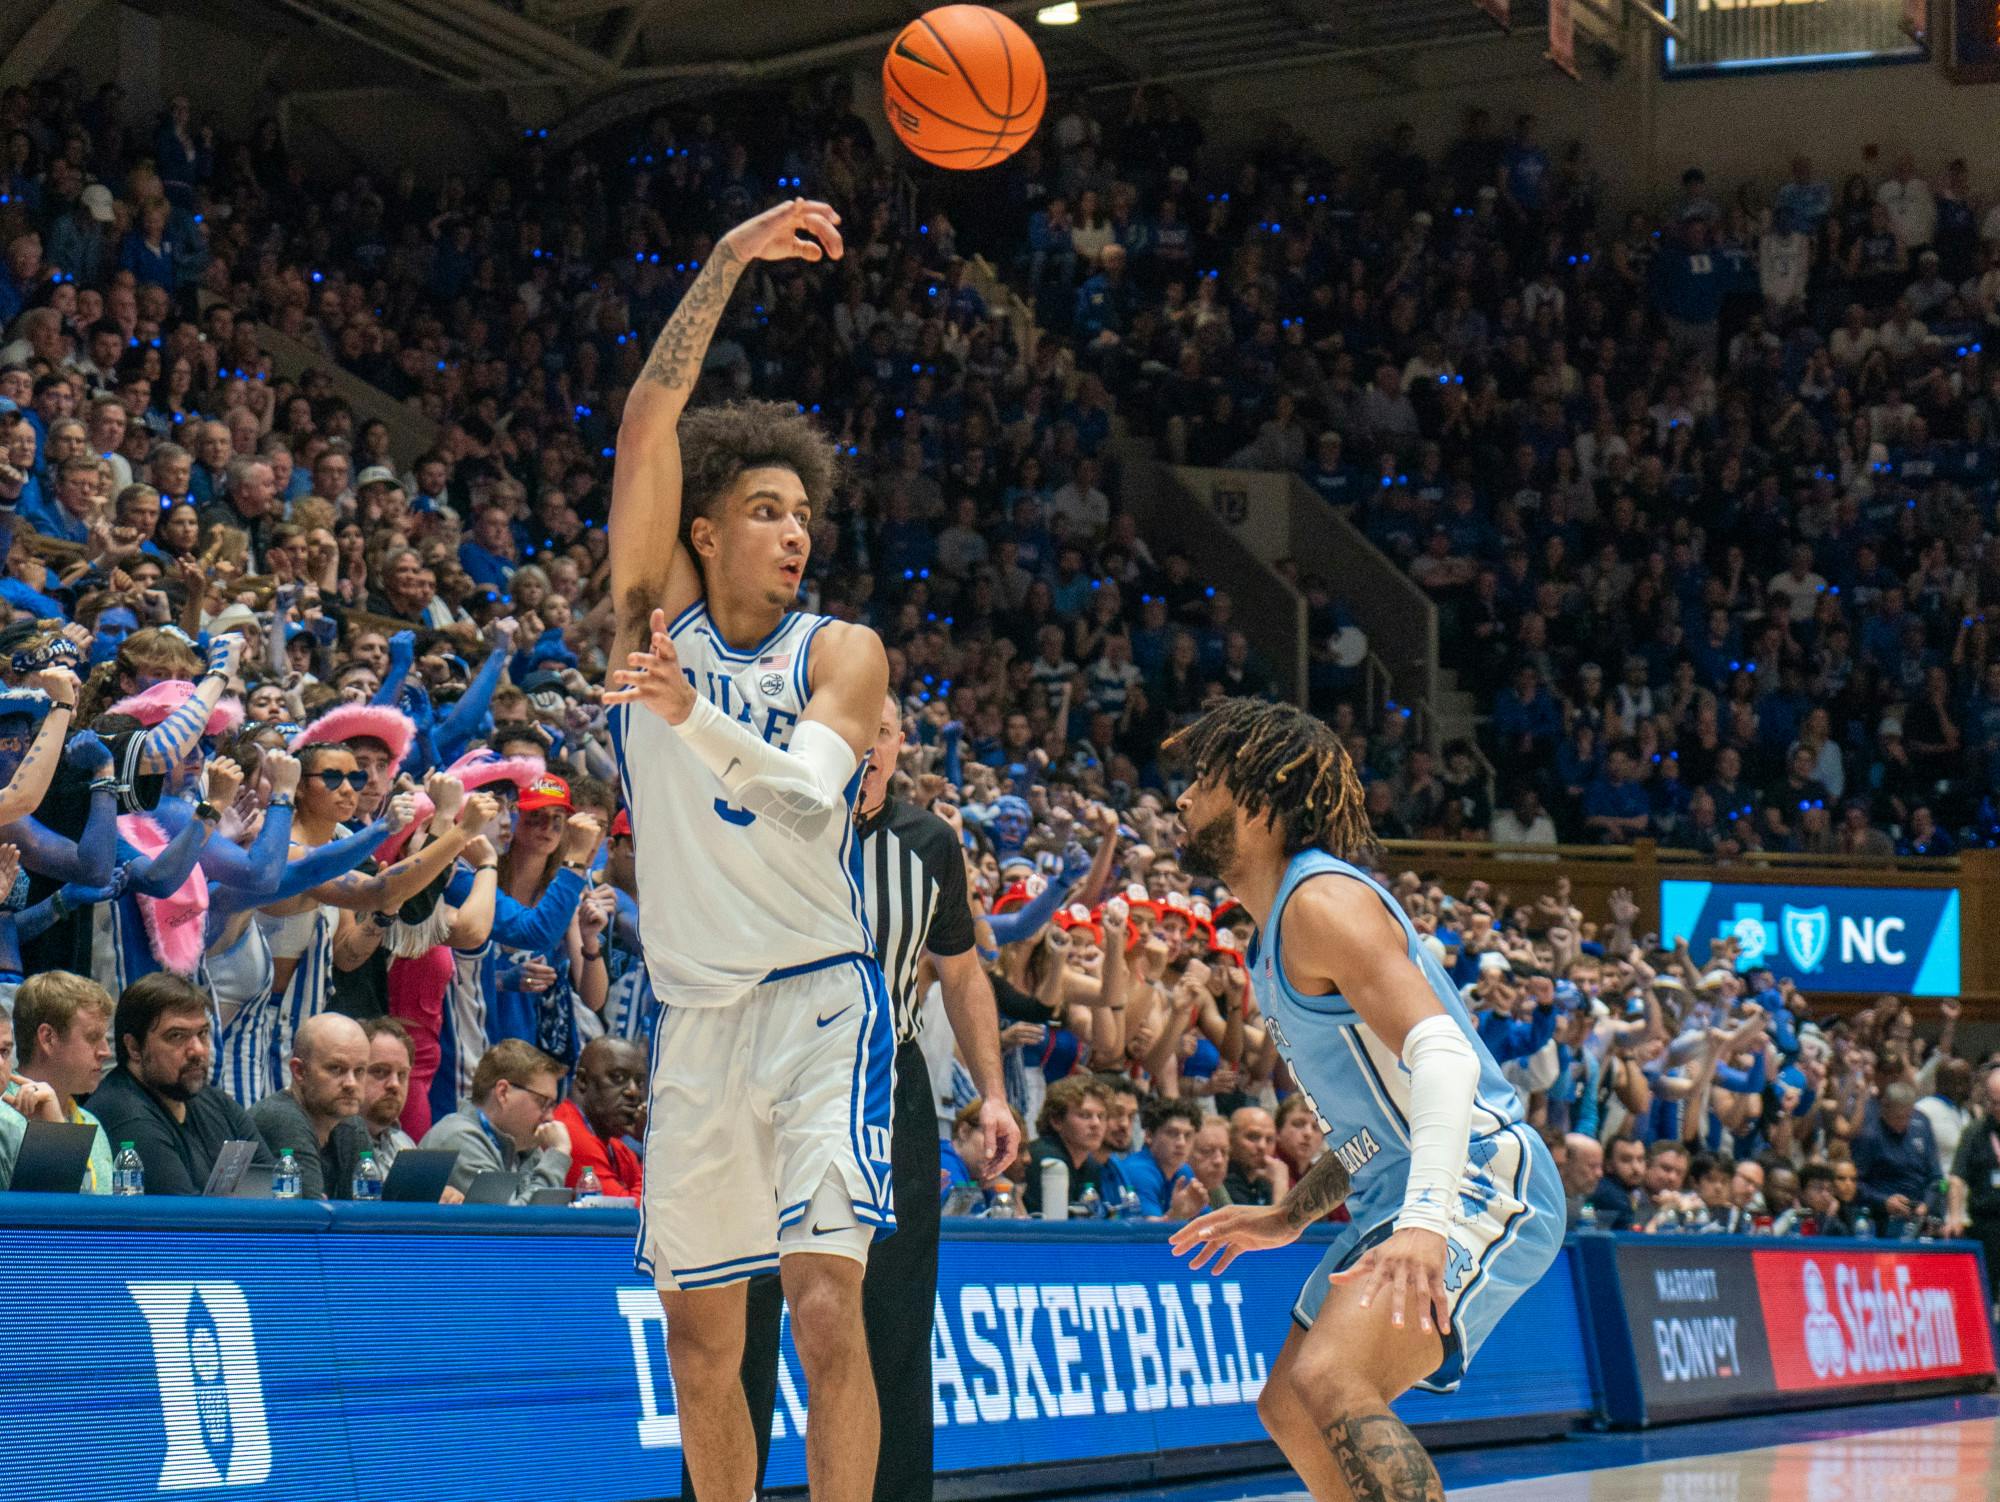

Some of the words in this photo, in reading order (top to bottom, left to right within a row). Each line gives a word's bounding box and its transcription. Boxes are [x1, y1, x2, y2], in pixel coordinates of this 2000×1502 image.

[1841, 916, 1906, 965] NC
[1655, 1268, 1718, 1301] MARRIOTT
[931, 1281, 1267, 1427] ASKETBALL
[1653, 1316, 1740, 1382] BONVOY
